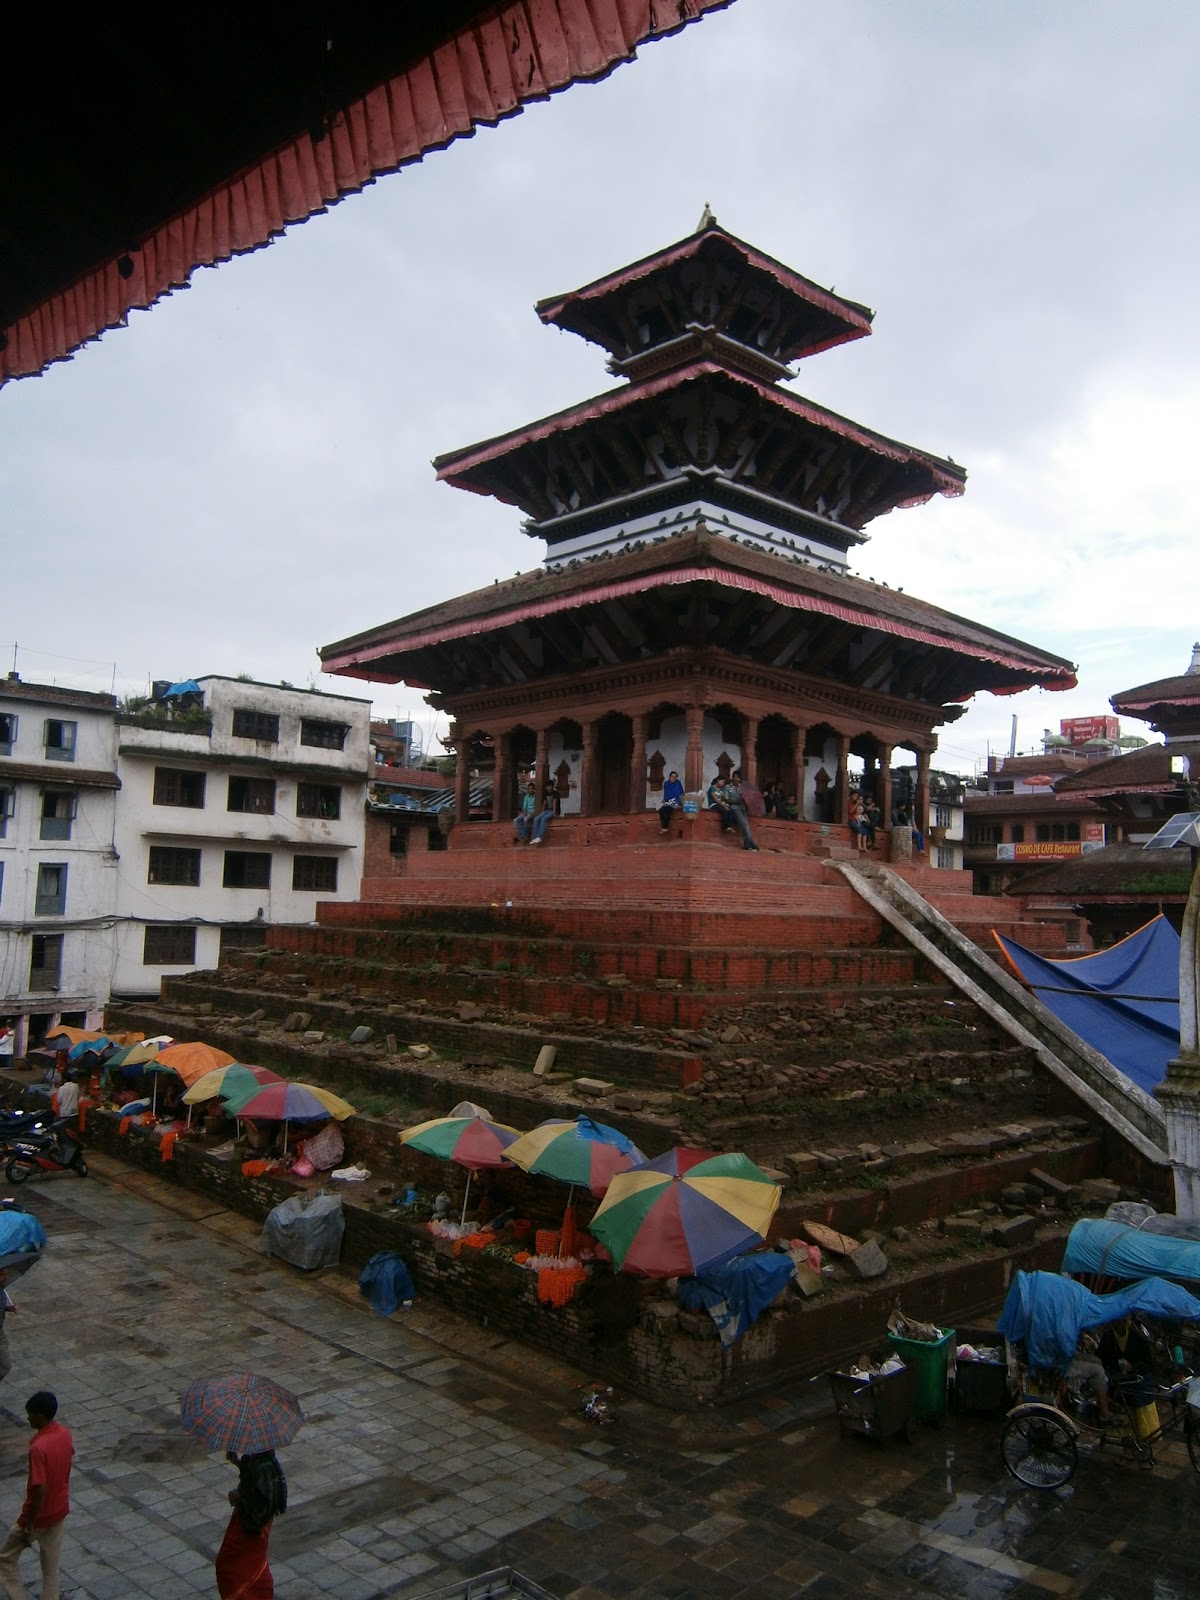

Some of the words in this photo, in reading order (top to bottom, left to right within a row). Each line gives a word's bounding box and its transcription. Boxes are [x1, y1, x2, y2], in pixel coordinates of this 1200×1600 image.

[1016, 845, 1033, 854] COSMO
[1034, 844, 1041, 853] DE
[1041, 844, 1054, 853] CAFE
[1054, 844, 1079, 853] Restaurant
